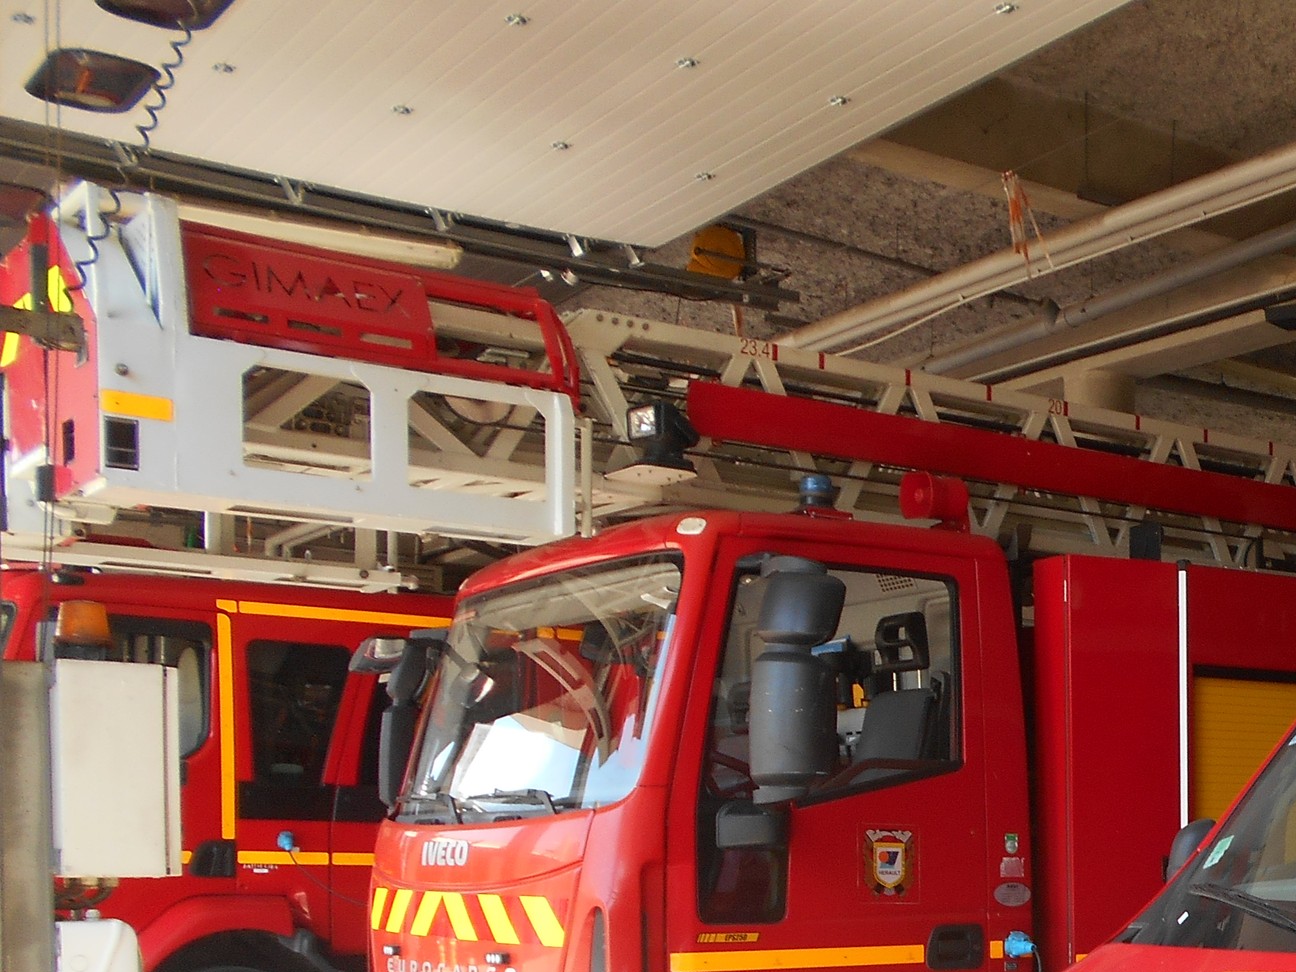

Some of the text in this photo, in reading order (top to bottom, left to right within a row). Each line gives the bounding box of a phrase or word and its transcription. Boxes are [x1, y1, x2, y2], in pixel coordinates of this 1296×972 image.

[203, 253, 411, 319] GIMAEX
[740, 337, 770, 358] 23.4
[1048, 398, 1062, 415] 20
[421, 840, 469, 867] IVECO
